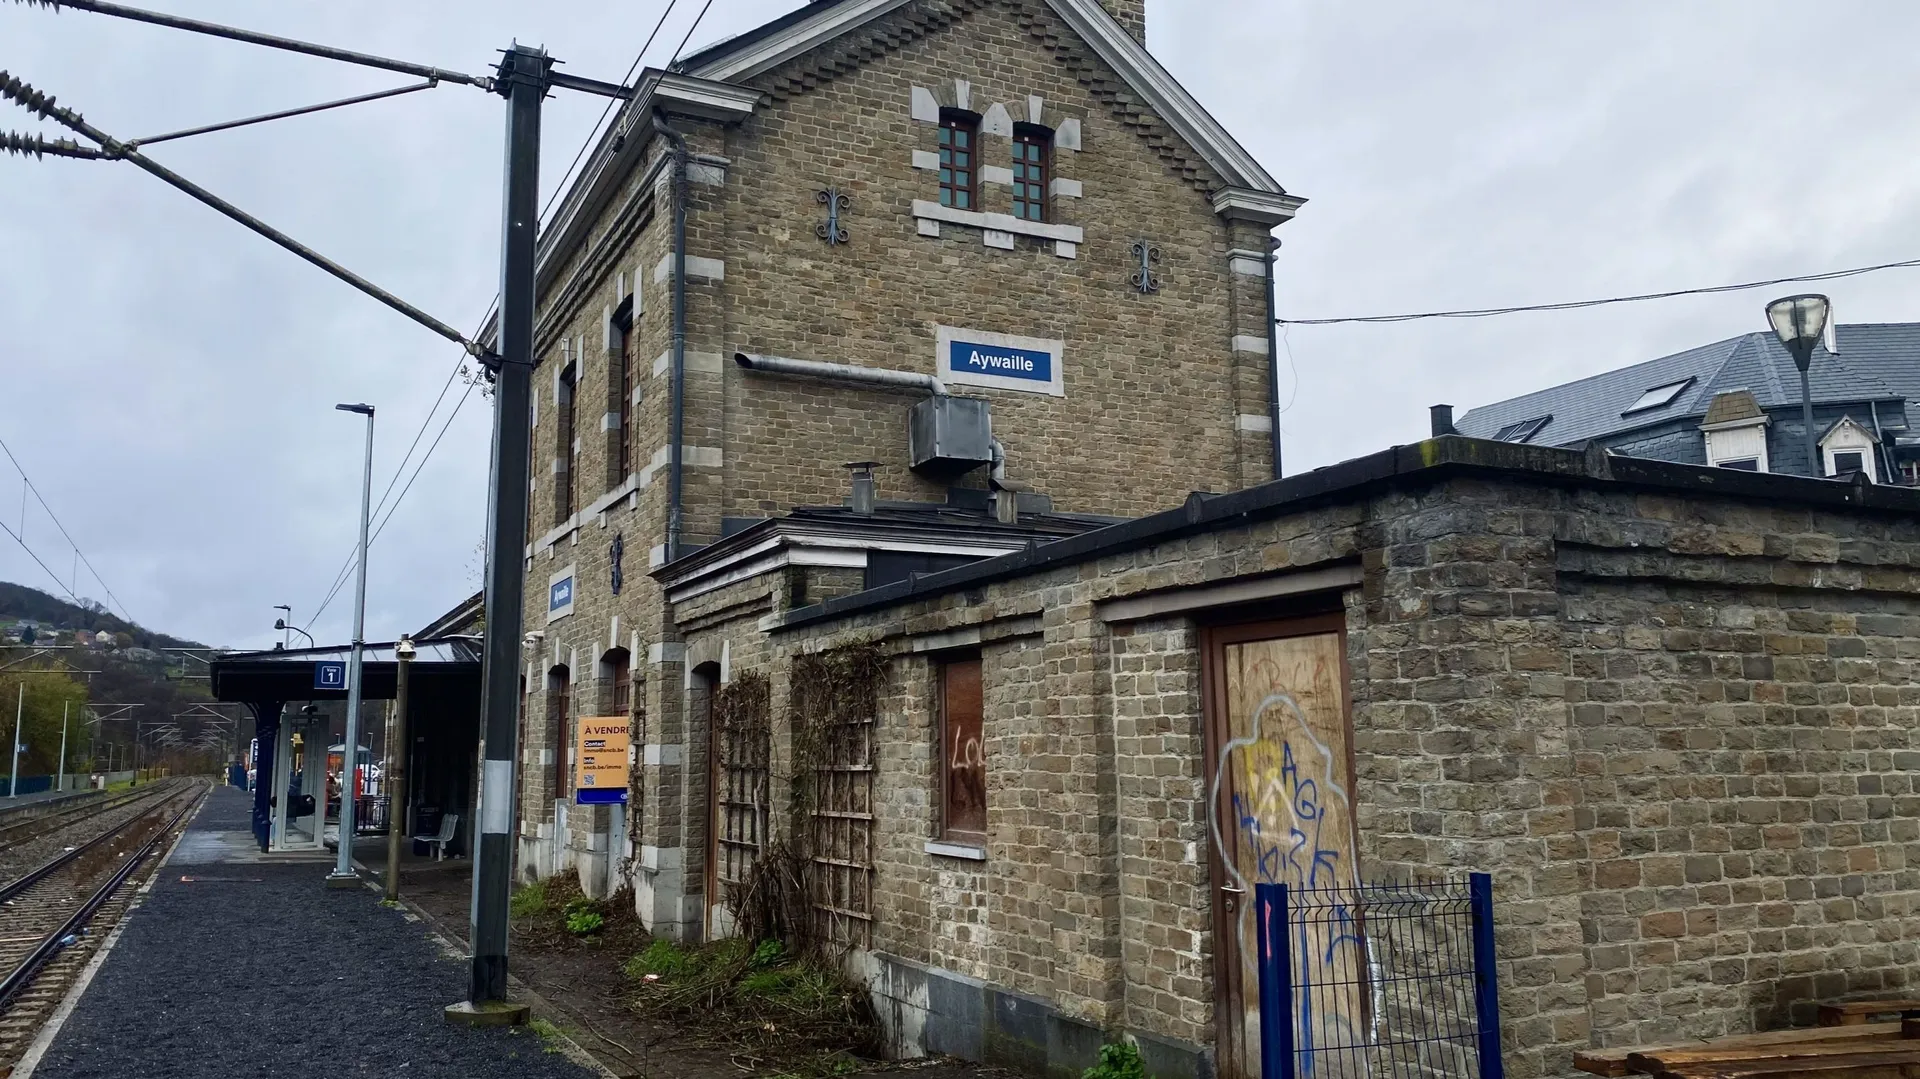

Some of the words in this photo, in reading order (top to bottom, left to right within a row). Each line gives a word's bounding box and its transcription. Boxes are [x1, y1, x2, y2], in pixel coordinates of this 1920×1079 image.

[969, 350, 1034, 372] Aywaille
[328, 672, 334, 683] 1
[584, 725, 592, 735] À
